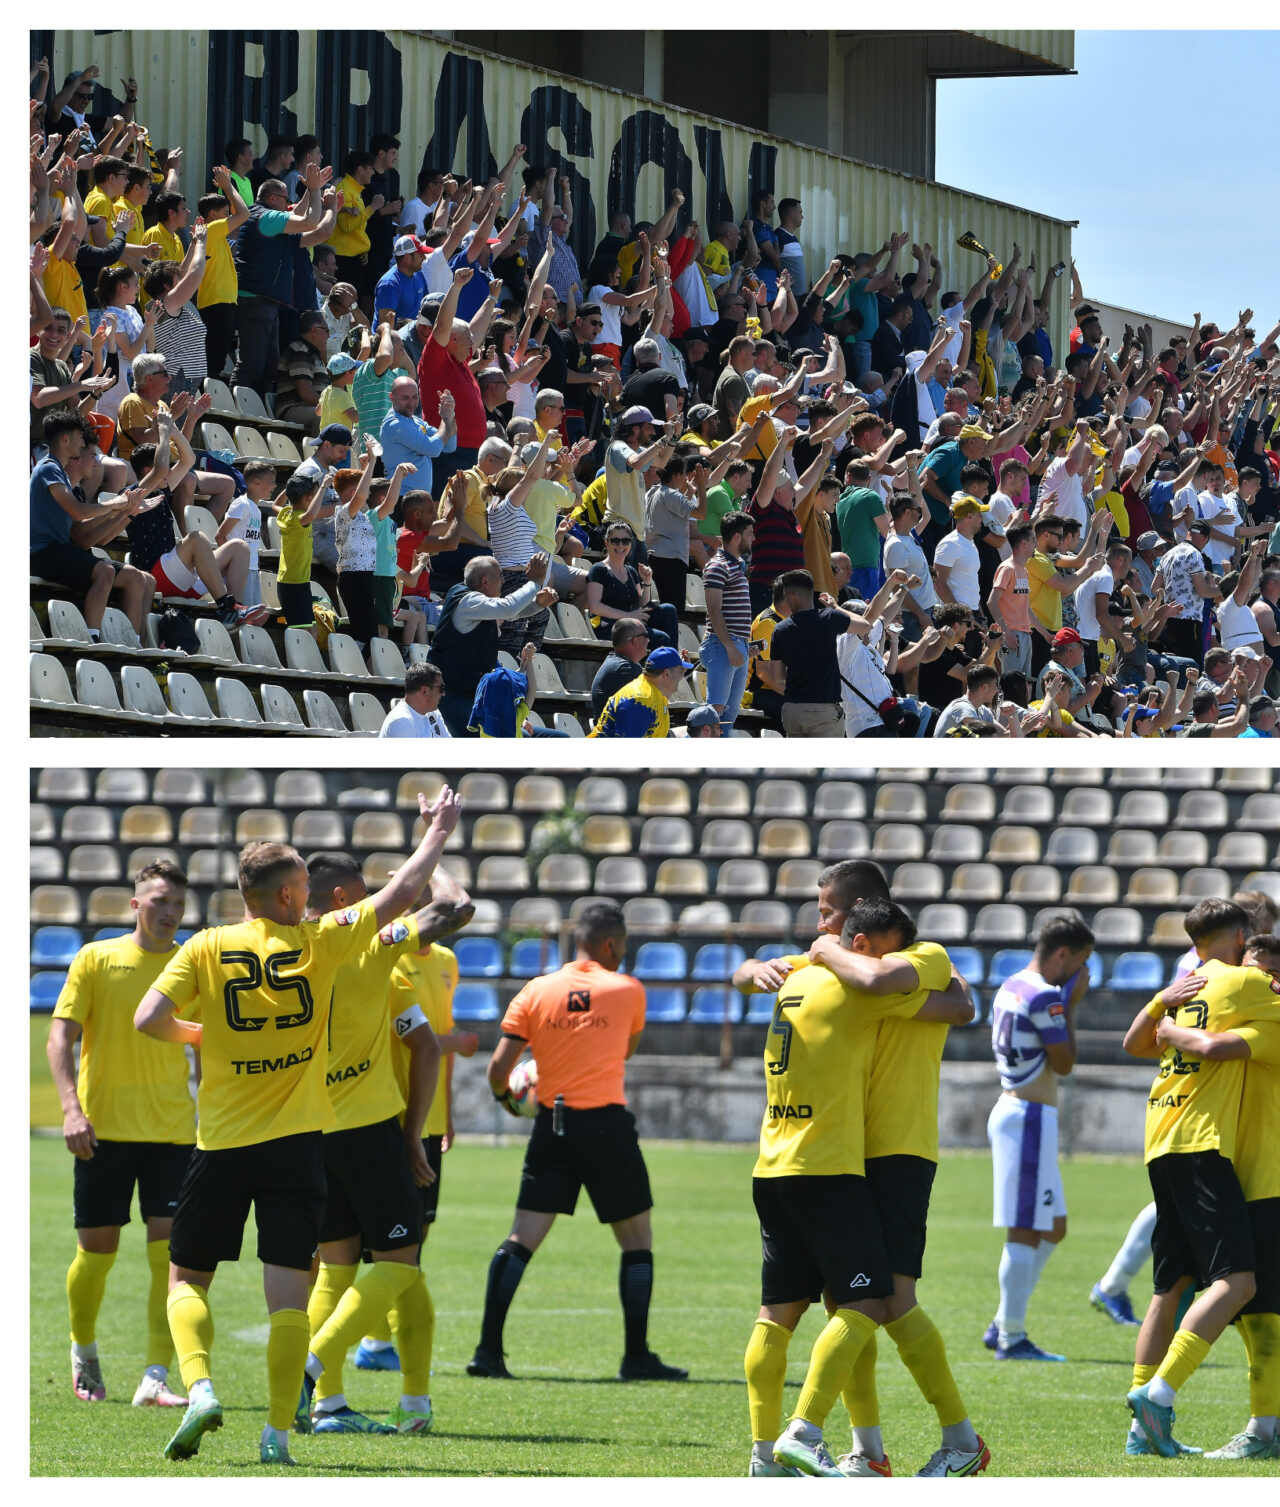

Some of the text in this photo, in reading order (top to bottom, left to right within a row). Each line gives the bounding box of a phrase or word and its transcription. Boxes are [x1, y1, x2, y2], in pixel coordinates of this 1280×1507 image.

[220, 949, 314, 1032] 25
[547, 1015, 609, 1030] NORDIS
[231, 1046, 313, 1075] TEMAD
